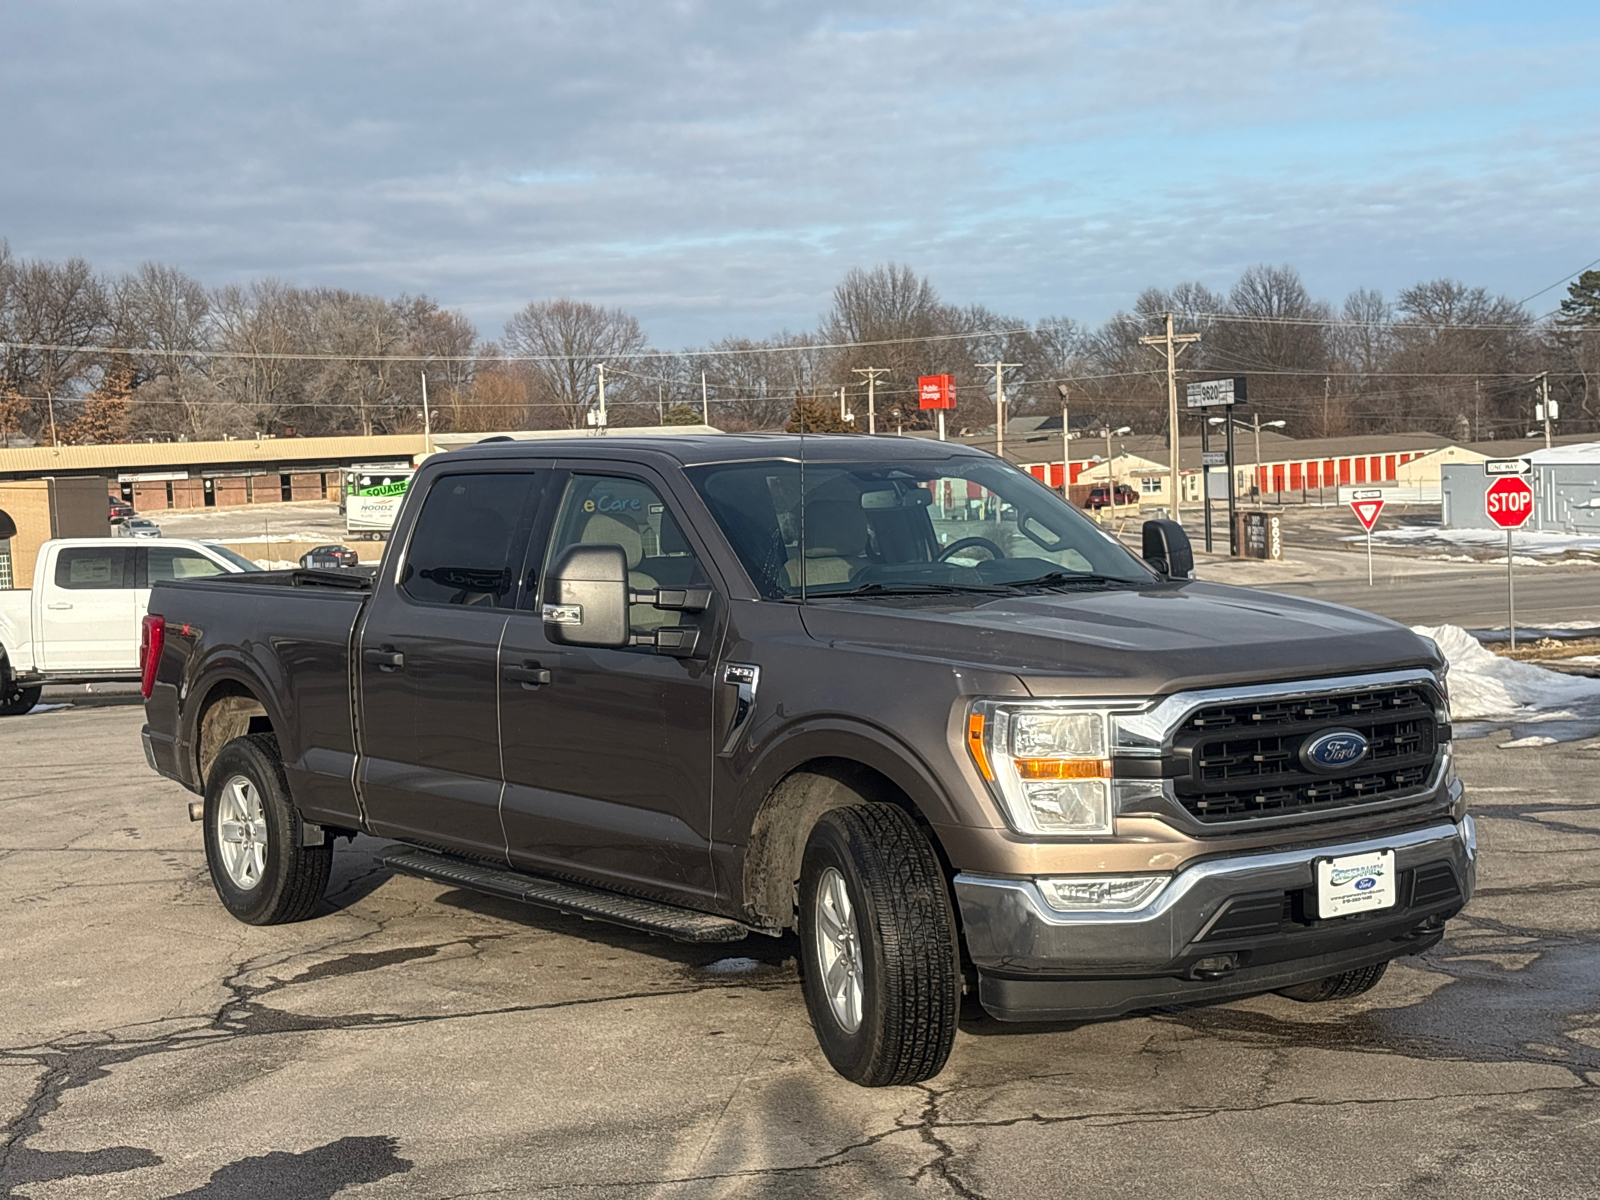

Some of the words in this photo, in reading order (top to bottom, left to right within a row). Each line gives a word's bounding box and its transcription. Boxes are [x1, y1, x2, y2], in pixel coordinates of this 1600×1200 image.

[921, 392, 940, 400] Storage
[1201, 385, 1219, 401] 9620
[366, 482, 407, 497] SQUARE
[1489, 491, 1530, 513] STOP
[1271, 517, 1281, 558] 9620
[1325, 740, 1357, 761] Ford
[1359, 880, 1373, 889] Ford
